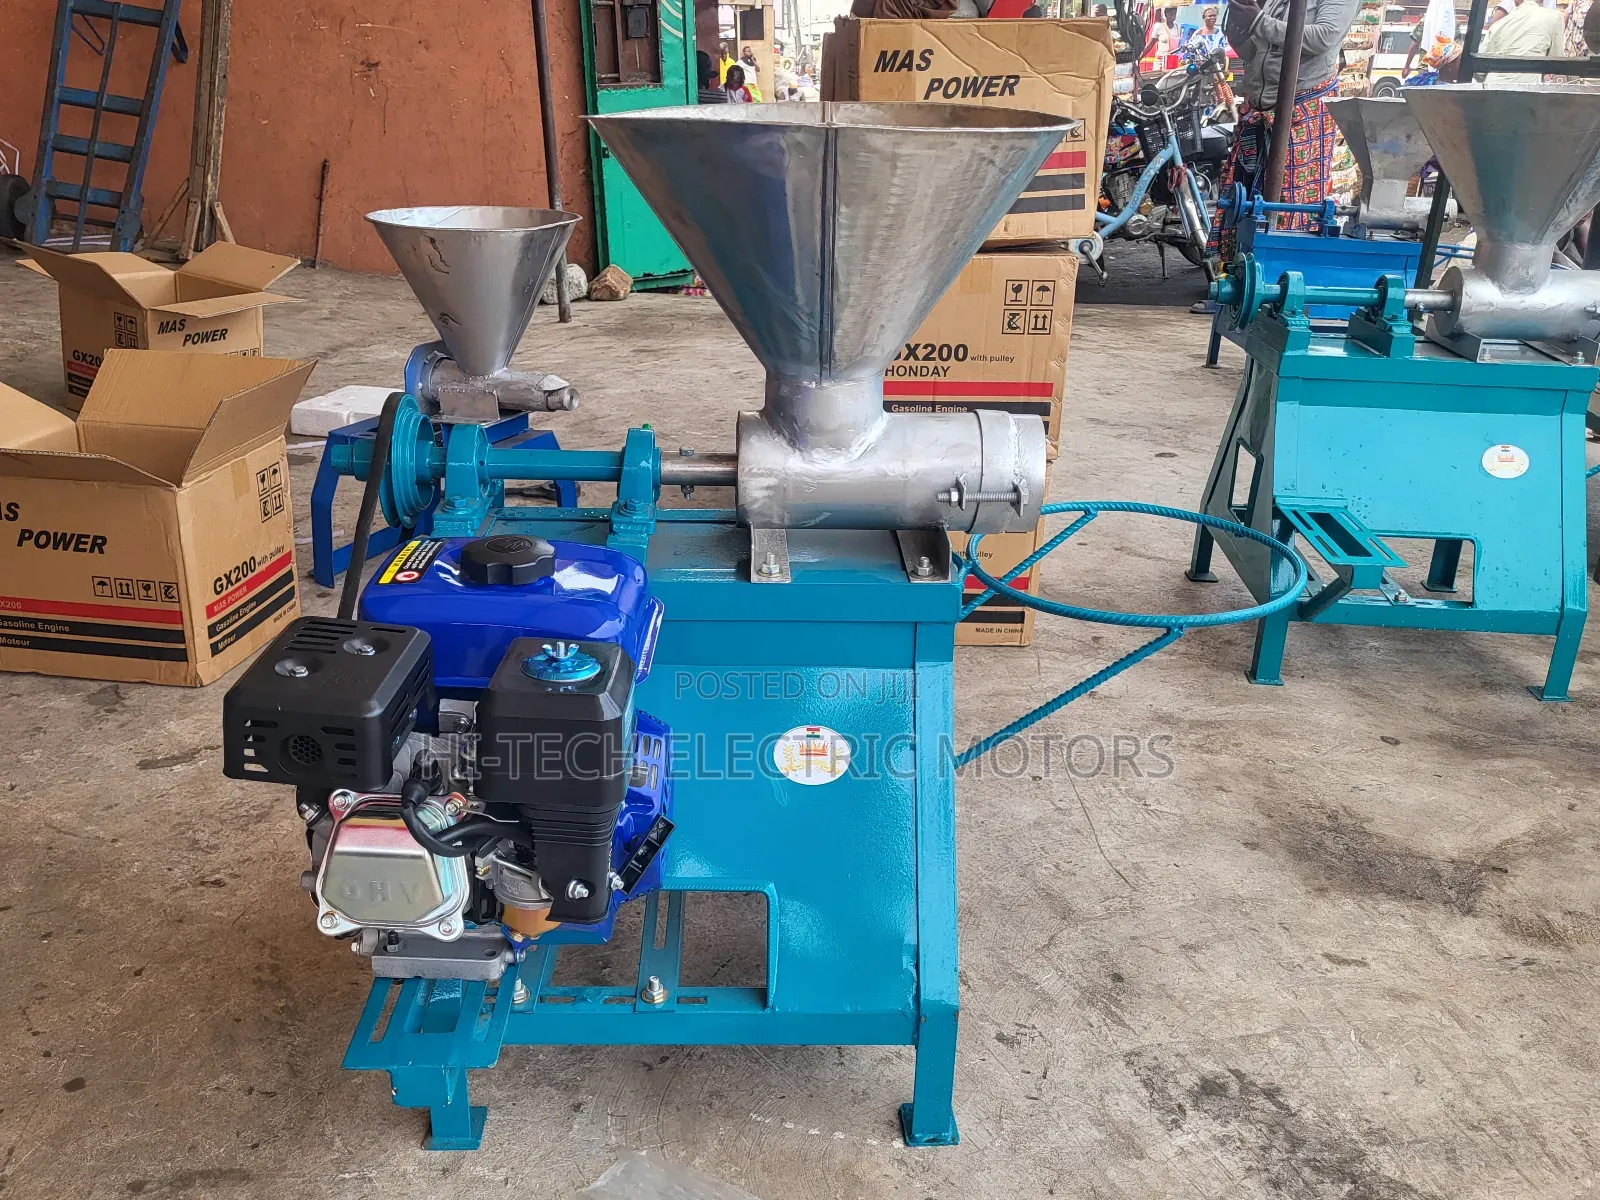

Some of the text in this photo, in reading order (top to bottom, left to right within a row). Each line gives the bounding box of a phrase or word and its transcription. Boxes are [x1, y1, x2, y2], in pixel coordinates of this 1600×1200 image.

[873, 48, 934, 73] MAS
[923, 74, 1020, 100] POWER
[157, 318, 187, 335] MAS
[182, 328, 228, 347] POWER
[72, 349, 103, 368] GX20
[893, 343, 1015, 364] X200 with pulley
[884, 365, 951, 378] HONDAY
[891, 404, 968, 413] Gasoline Engine
[16, 528, 108, 554] POWER
[213, 543, 285, 596] GX200 with pulley
[0, 600, 22, 609] X200
[213, 585, 248, 613] MAS POWER
[215, 600, 257, 632] Gasoline Engine
[37, 621, 70, 633] Engine
[339, 879, 423, 904] OHV
